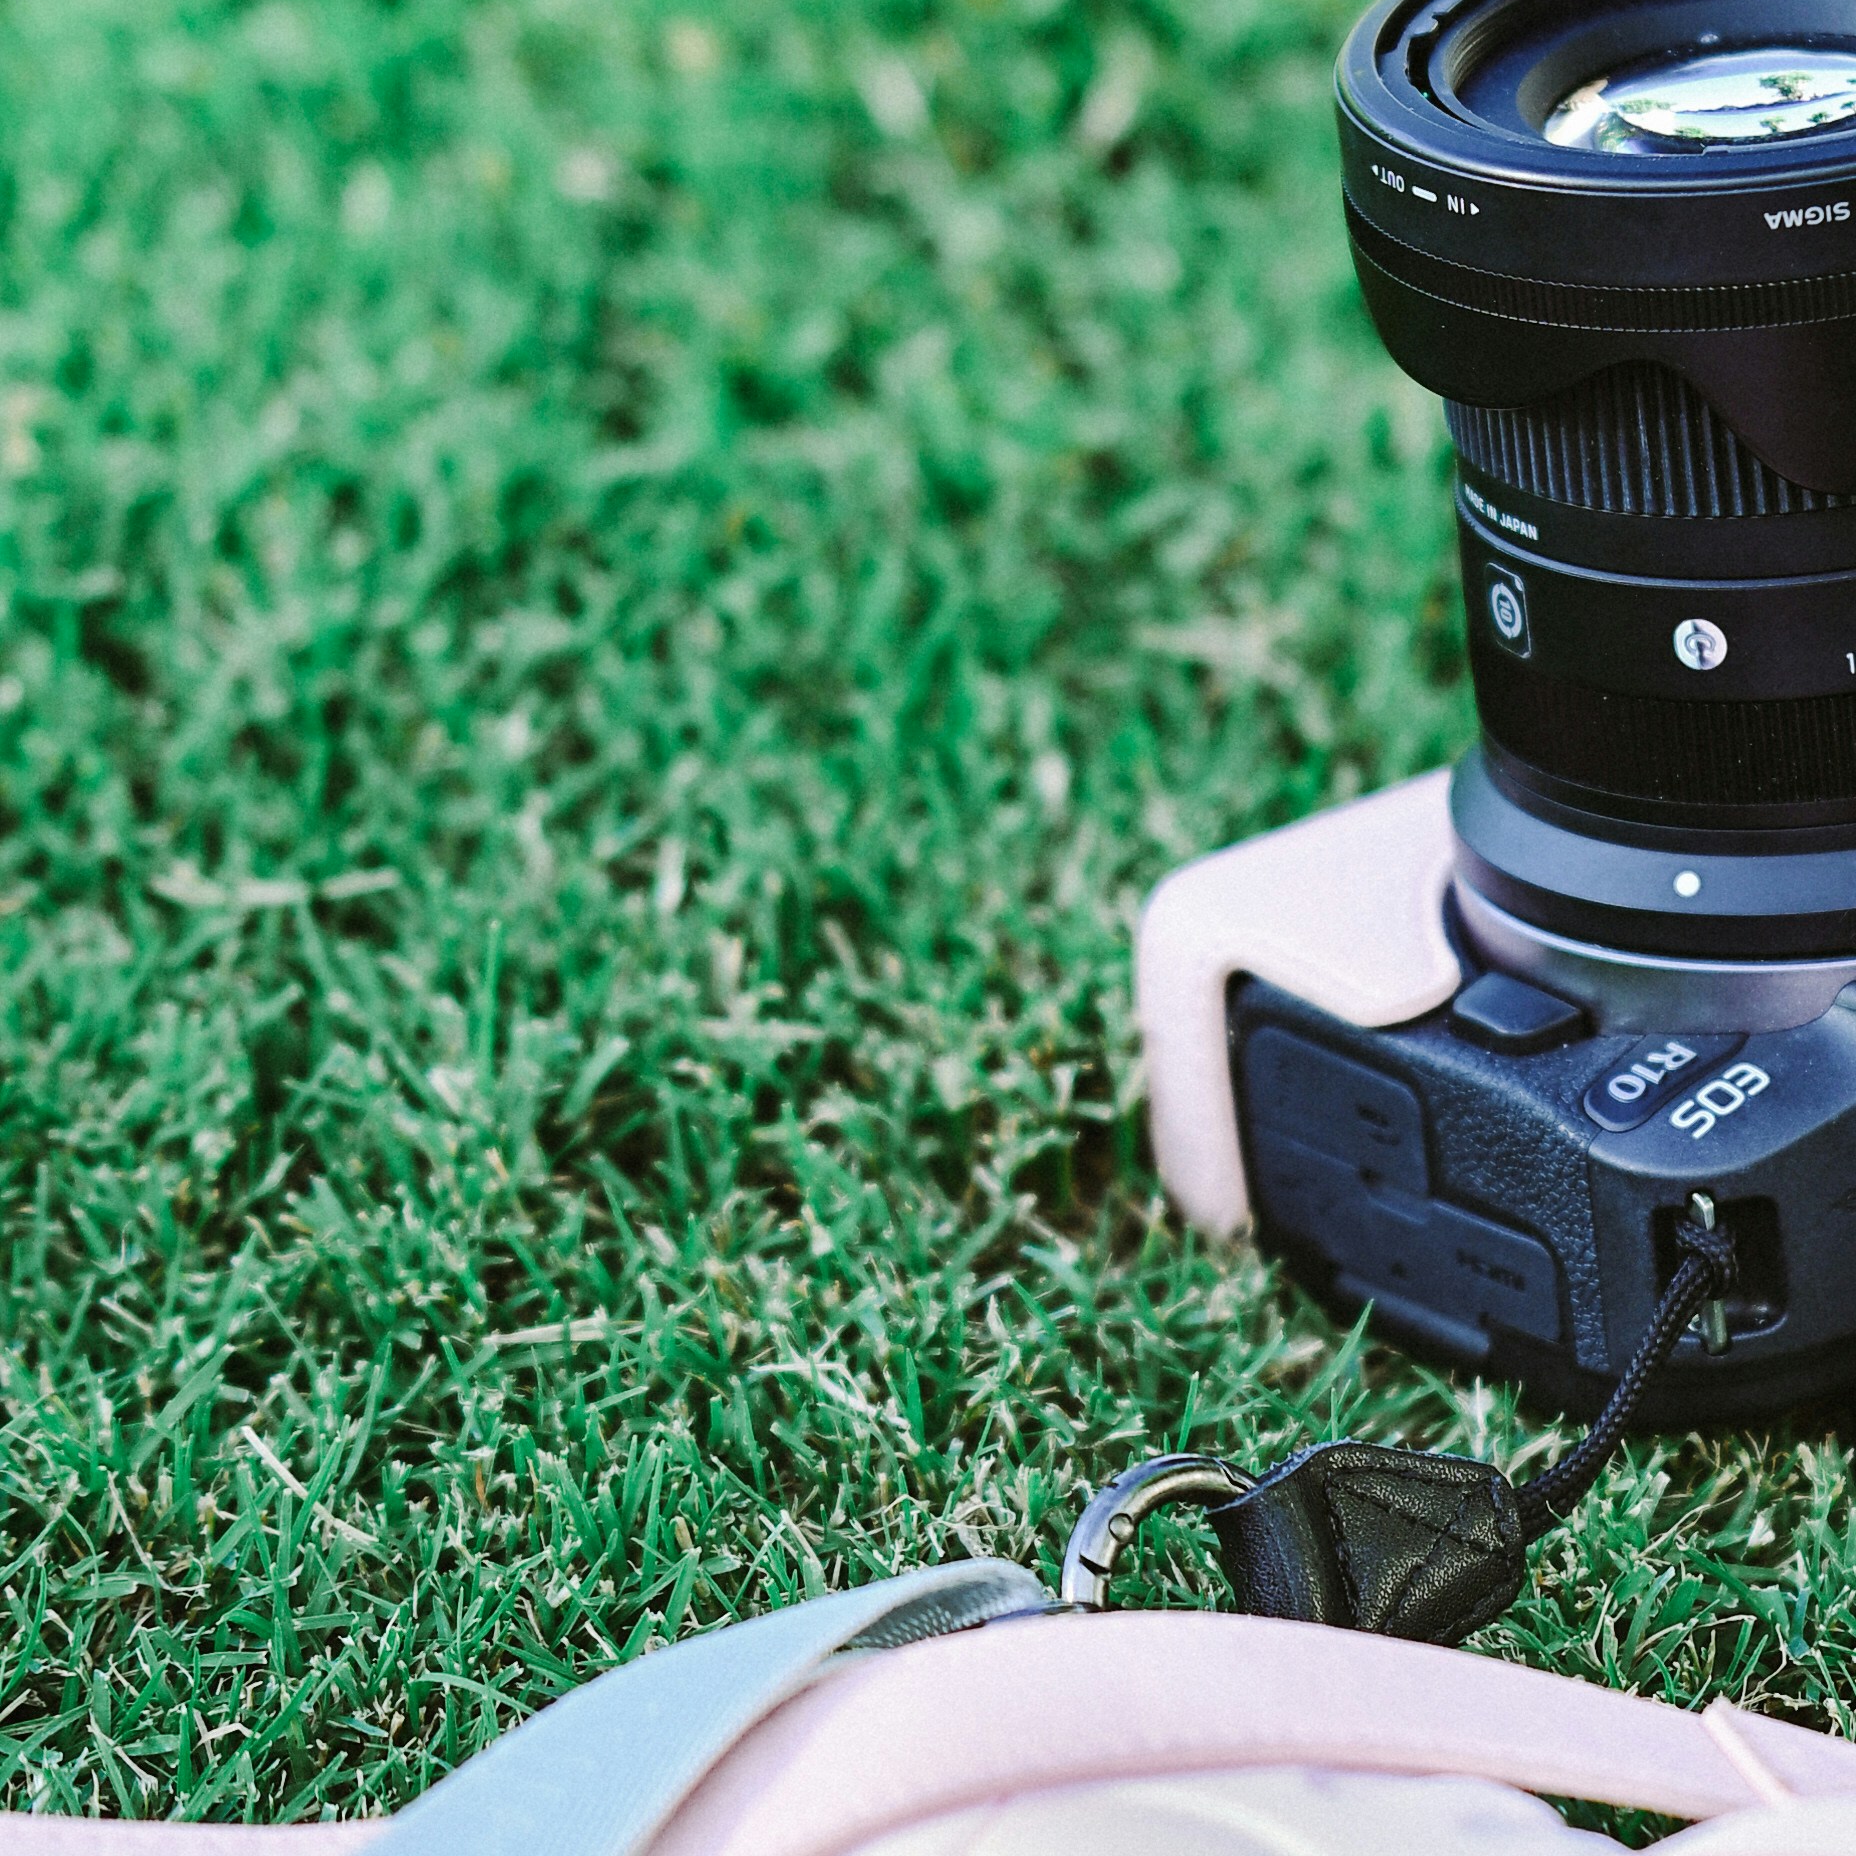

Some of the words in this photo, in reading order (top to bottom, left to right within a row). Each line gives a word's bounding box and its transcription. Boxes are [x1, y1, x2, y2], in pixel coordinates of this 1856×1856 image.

[1380, 166, 1405, 193] OUT
[1447, 193, 1465, 216] IN
[1763, 201, 1851, 230] SIGMA
[1500, 512, 1539, 541] JAPAN
[1607, 1041, 1698, 1104] R10
[1669, 1062, 1771, 1140] EOS
